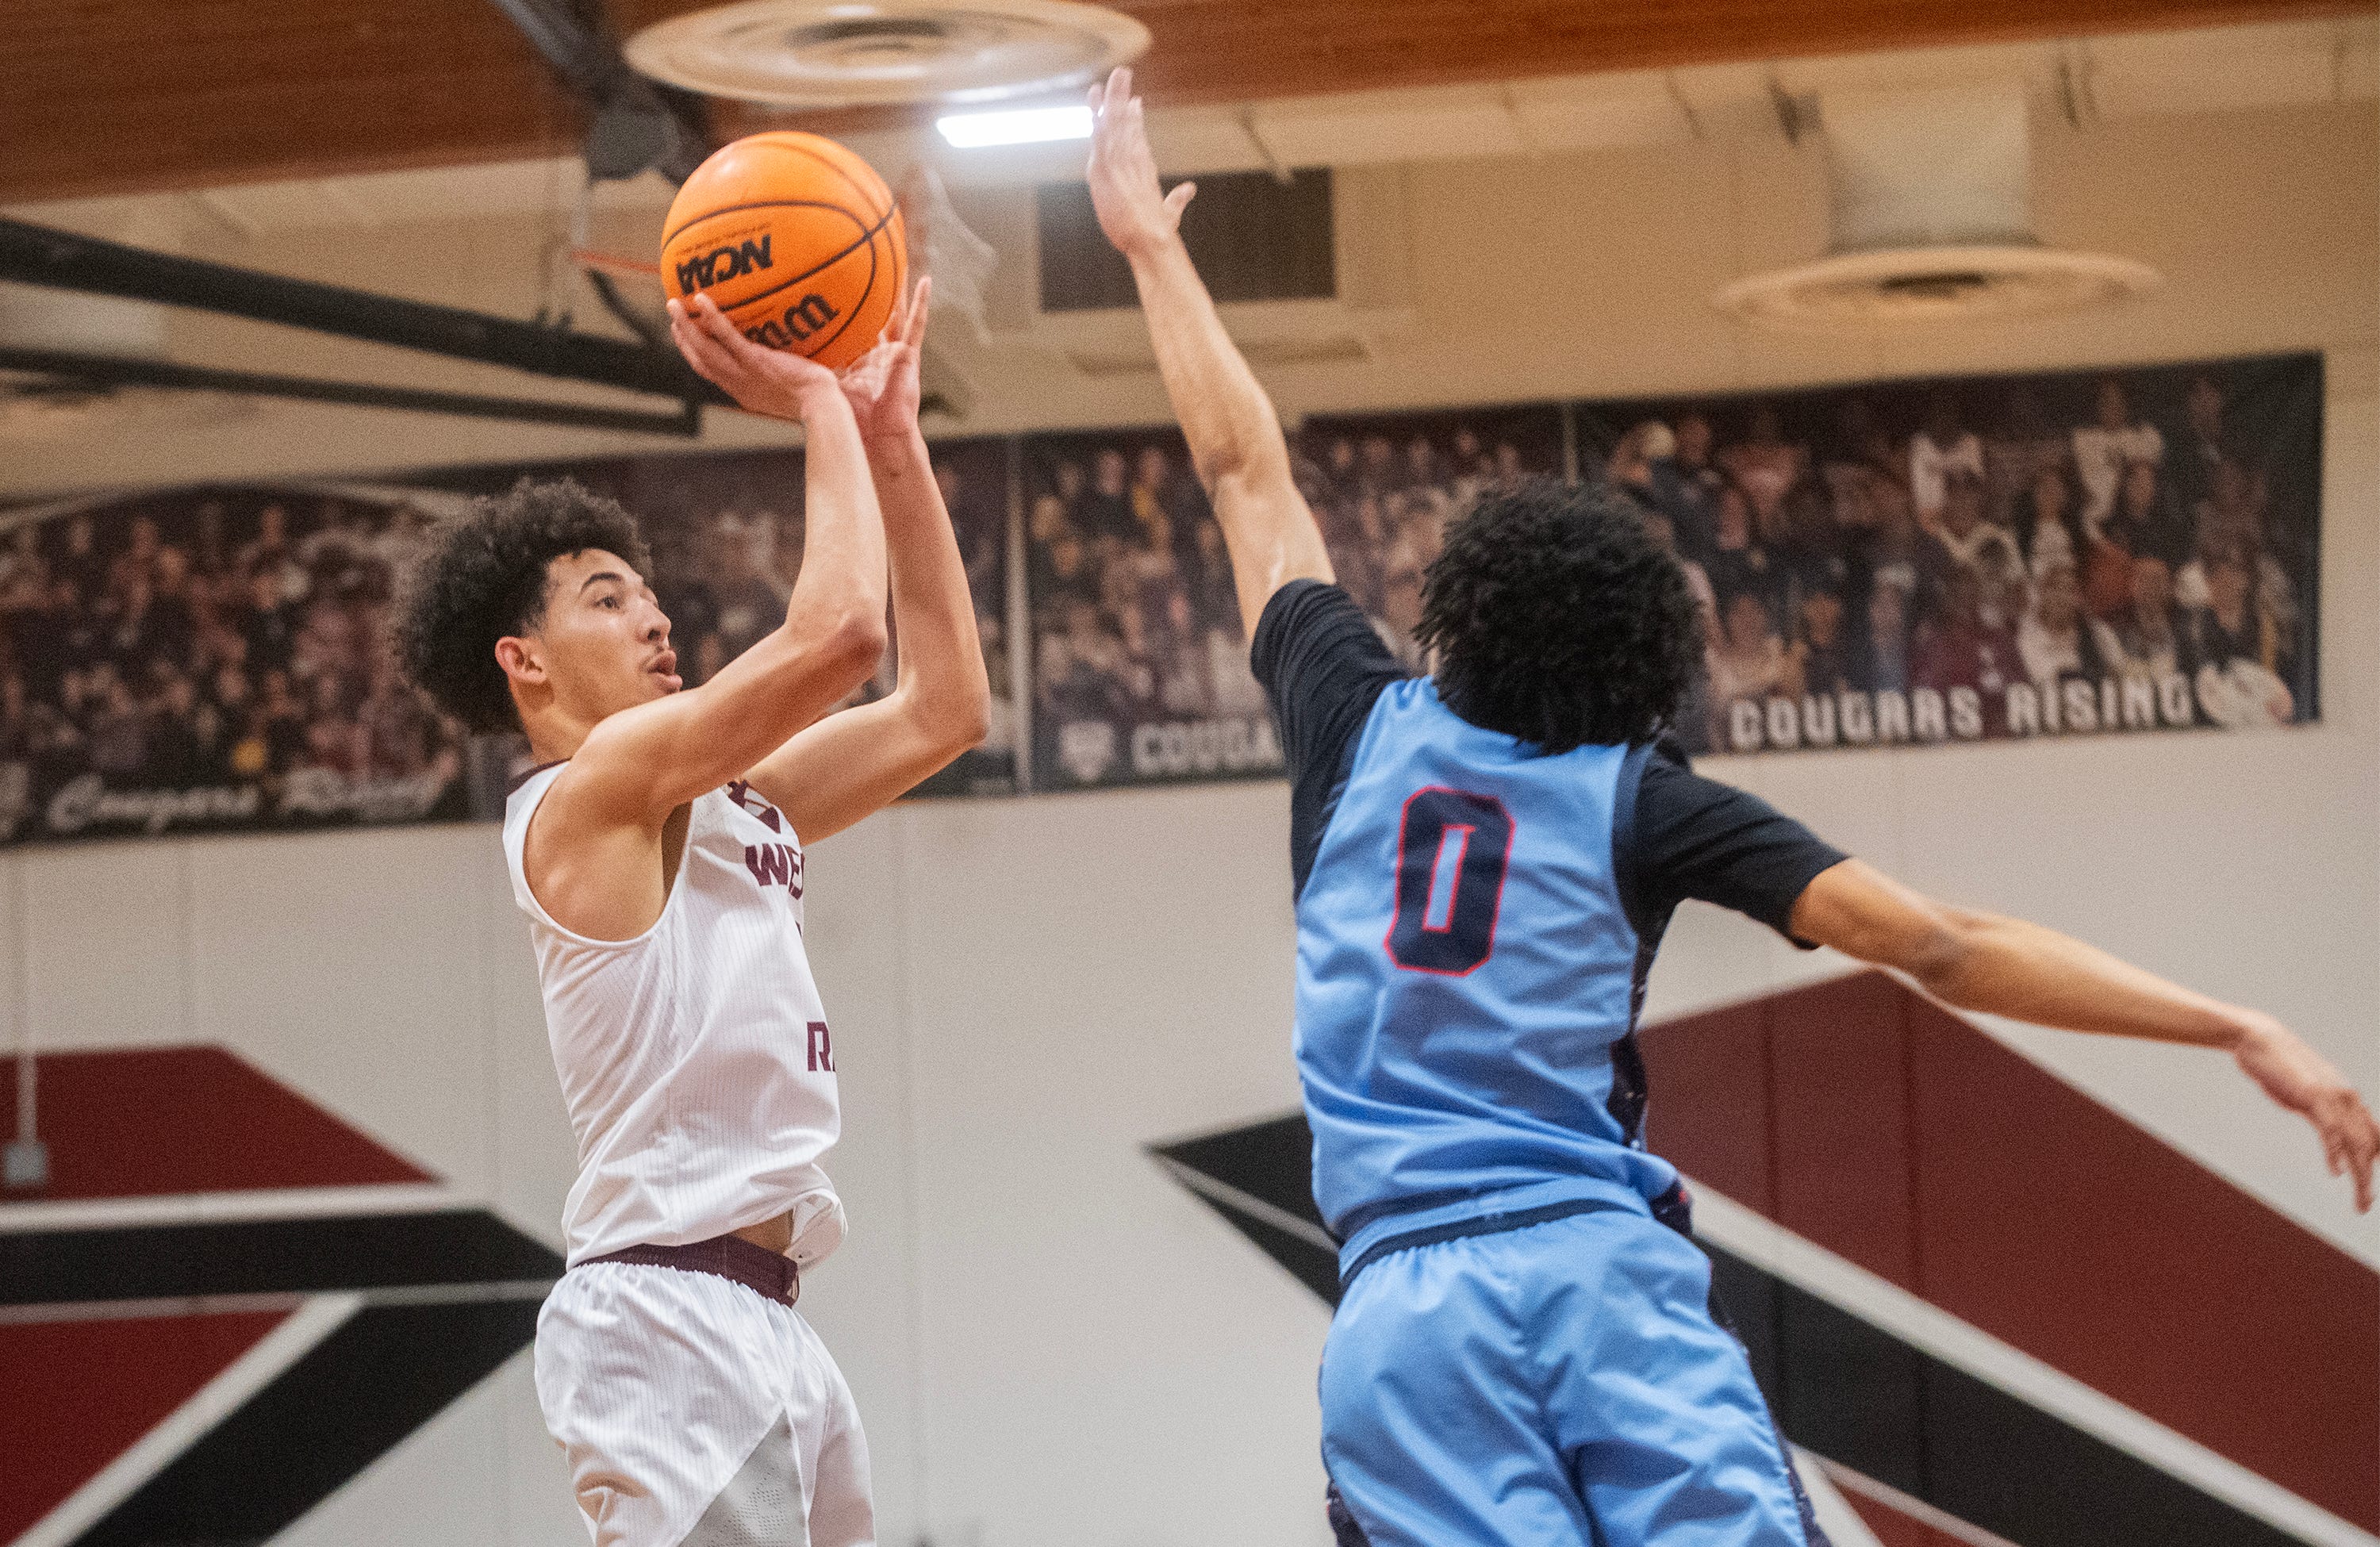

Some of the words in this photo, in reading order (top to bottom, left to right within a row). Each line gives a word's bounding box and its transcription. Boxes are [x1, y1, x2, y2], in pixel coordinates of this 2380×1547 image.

[675, 234, 773, 296] NCAA
[745, 293, 839, 350] Wil
[1730, 684, 1983, 750] COUGARS
[2006, 673, 2193, 735] RISING
[1132, 717, 1284, 770] COUGA
[745, 843, 805, 900] WE
[1383, 785, 1516, 977] 0
[807, 1021, 835, 1072] R
